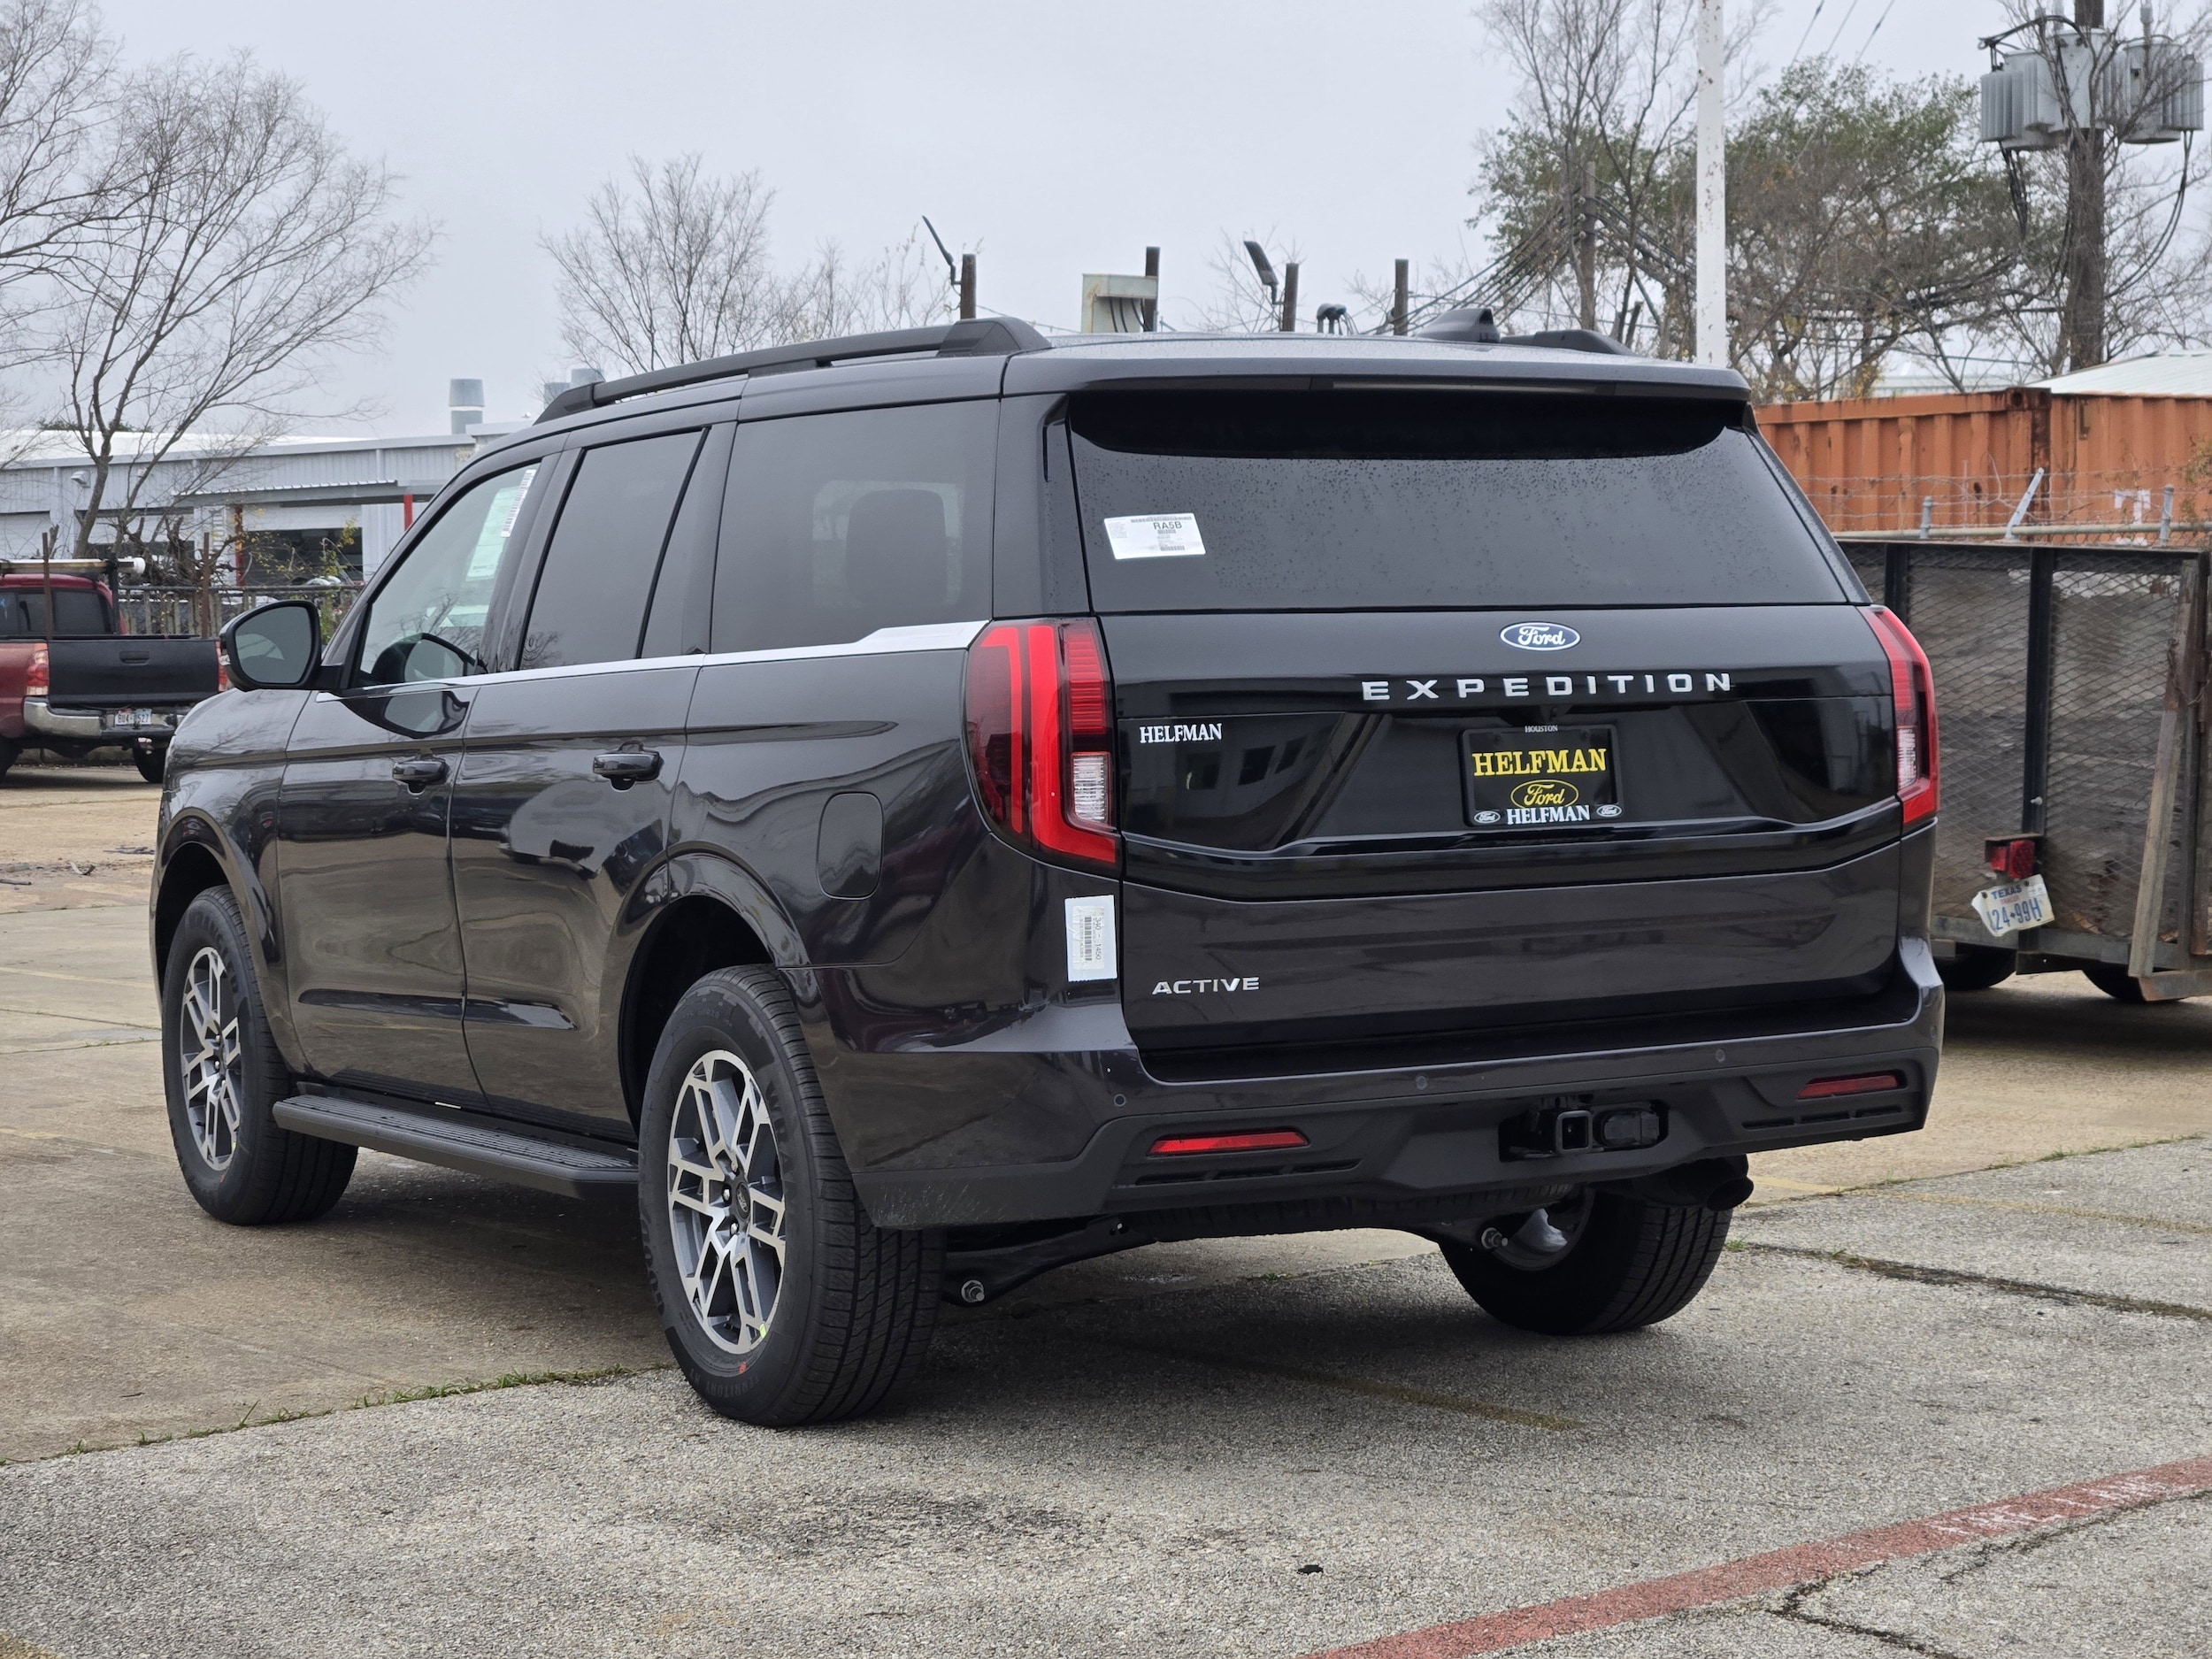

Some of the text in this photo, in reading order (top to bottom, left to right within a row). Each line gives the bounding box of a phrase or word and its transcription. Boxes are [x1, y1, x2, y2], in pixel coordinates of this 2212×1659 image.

[1153, 521, 1182, 530] RA5B
[1518, 626, 1565, 646] Ford
[1361, 672, 1732, 703] EXPEDITION
[1140, 723, 1222, 743] HELFMAN
[1472, 749, 1607, 776] HELFMAN
[1524, 783, 1565, 806] Ford
[1506, 805, 1591, 825] HELFMAN
[1991, 886, 2022, 900] TEXAS
[1152, 977, 1259, 995] ACTIVE
